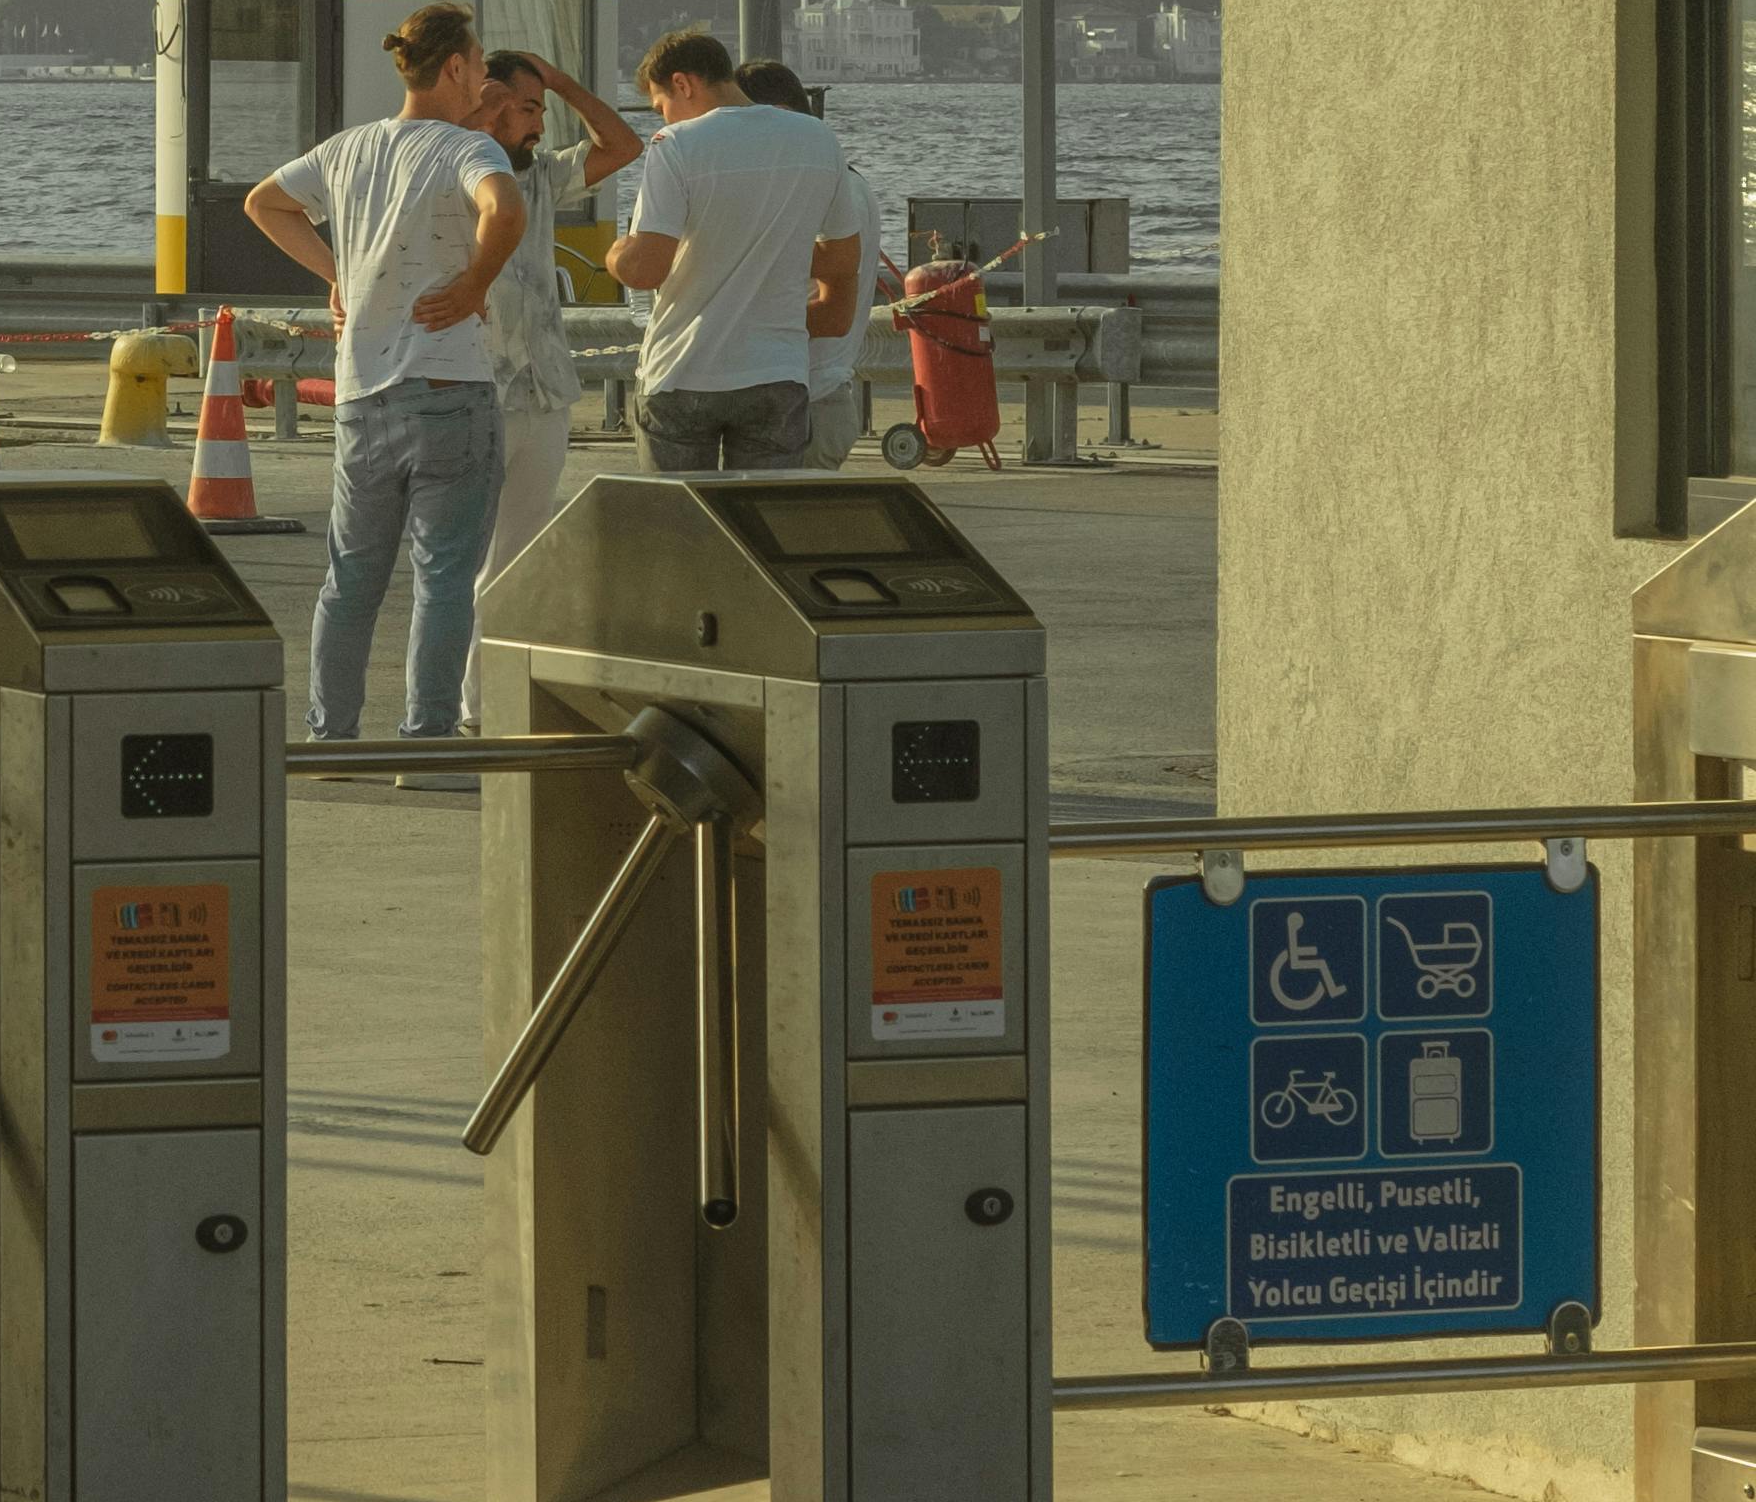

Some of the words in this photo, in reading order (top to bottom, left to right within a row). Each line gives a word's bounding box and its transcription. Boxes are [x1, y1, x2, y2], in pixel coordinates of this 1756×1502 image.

[946, 915, 983, 926] BANKA
[169, 933, 210, 944] BANKA
[957, 961, 990, 971] CARDS
[181, 980, 215, 990] CARDS
[912, 977, 964, 987] ACCEPTED
[133, 995, 188, 1006] ACCEPTED
[1270, 1182, 1374, 1220] Engelli,
[1380, 1177, 1481, 1208] Pusetli,
[1249, 1228, 1371, 1261] Bisikletli
[1377, 1233, 1409, 1254] ve
[1414, 1223, 1500, 1253] Valizli
[1248, 1278, 1322, 1307] Yolcu
[1329, 1274, 1407, 1308] Geçişi
[1415, 1265, 1503, 1306] İçindir
